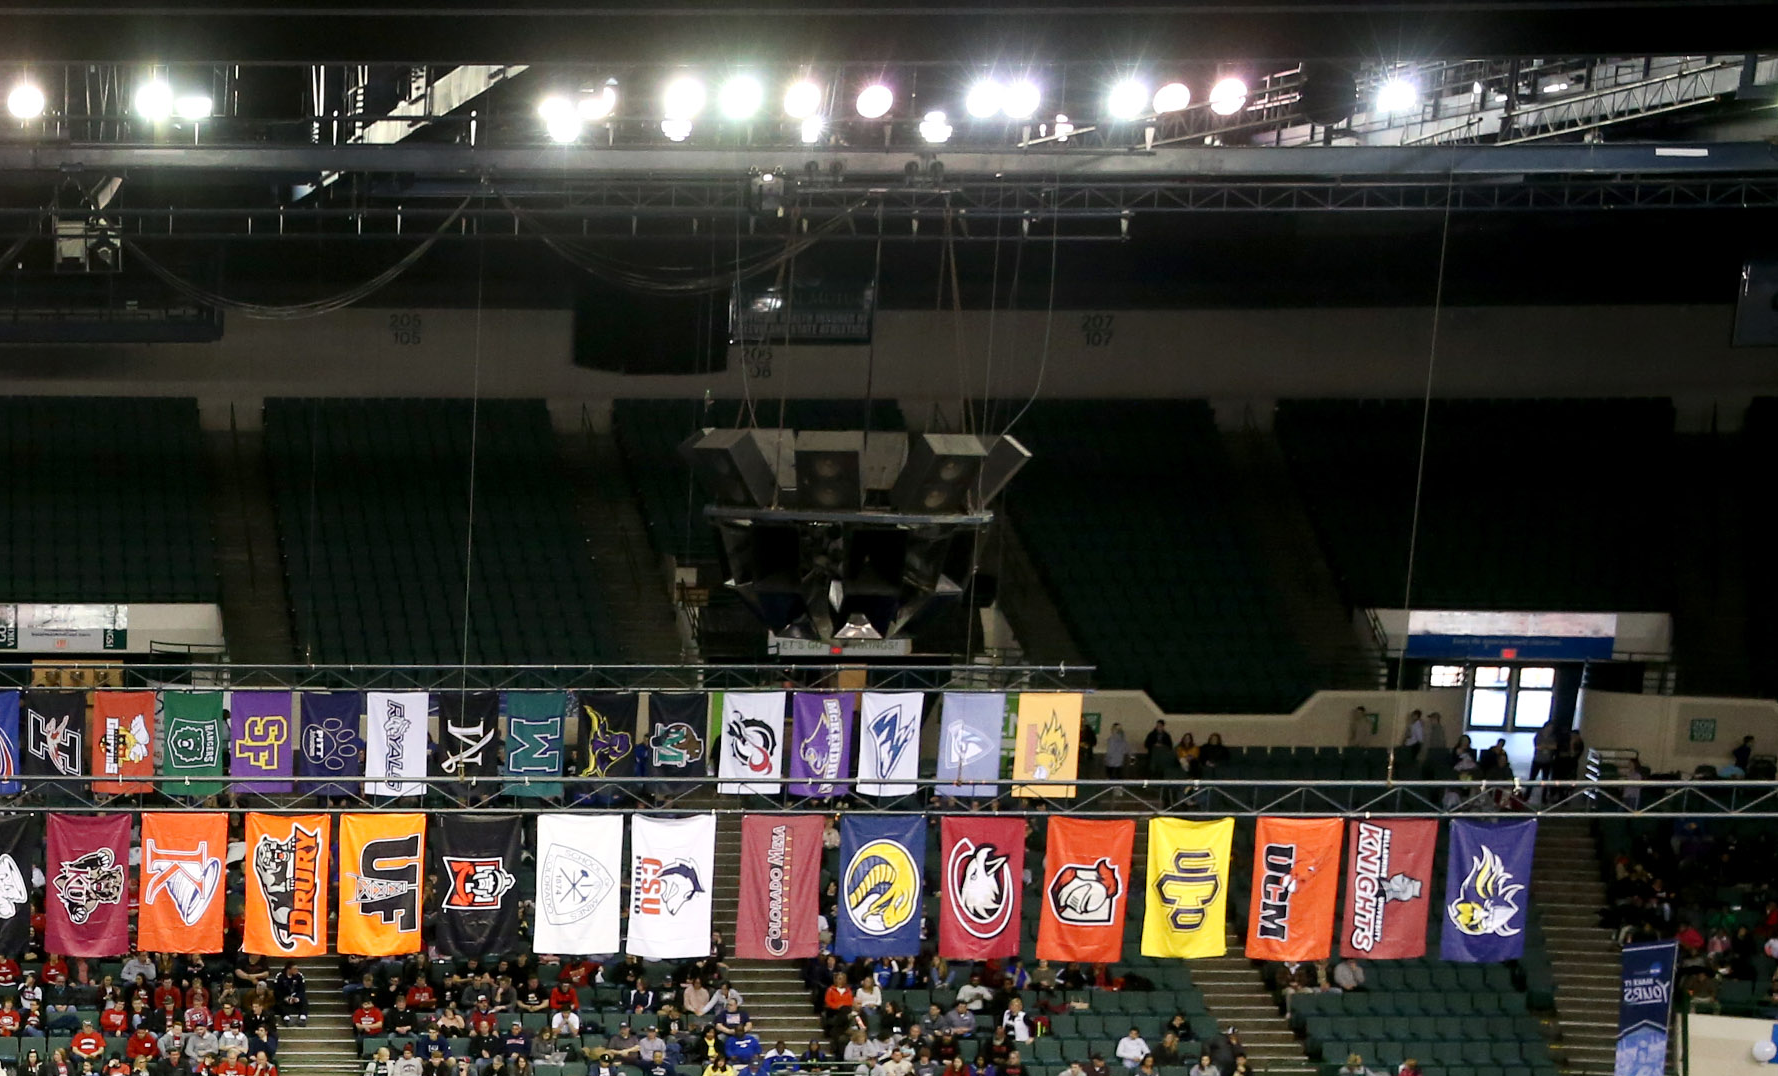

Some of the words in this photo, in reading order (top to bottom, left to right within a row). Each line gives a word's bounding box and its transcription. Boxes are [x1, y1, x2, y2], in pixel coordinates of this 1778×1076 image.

[204, 724, 215, 763] RANGERS
[315, 730, 324, 759] PITT
[289, 829, 318, 938] DRURY
[634, 855, 642, 915] PUEBLO
[642, 857, 663, 915] CSU
[765, 866, 789, 957] COLORADO
[1353, 823, 1382, 951] KNIGHTS
